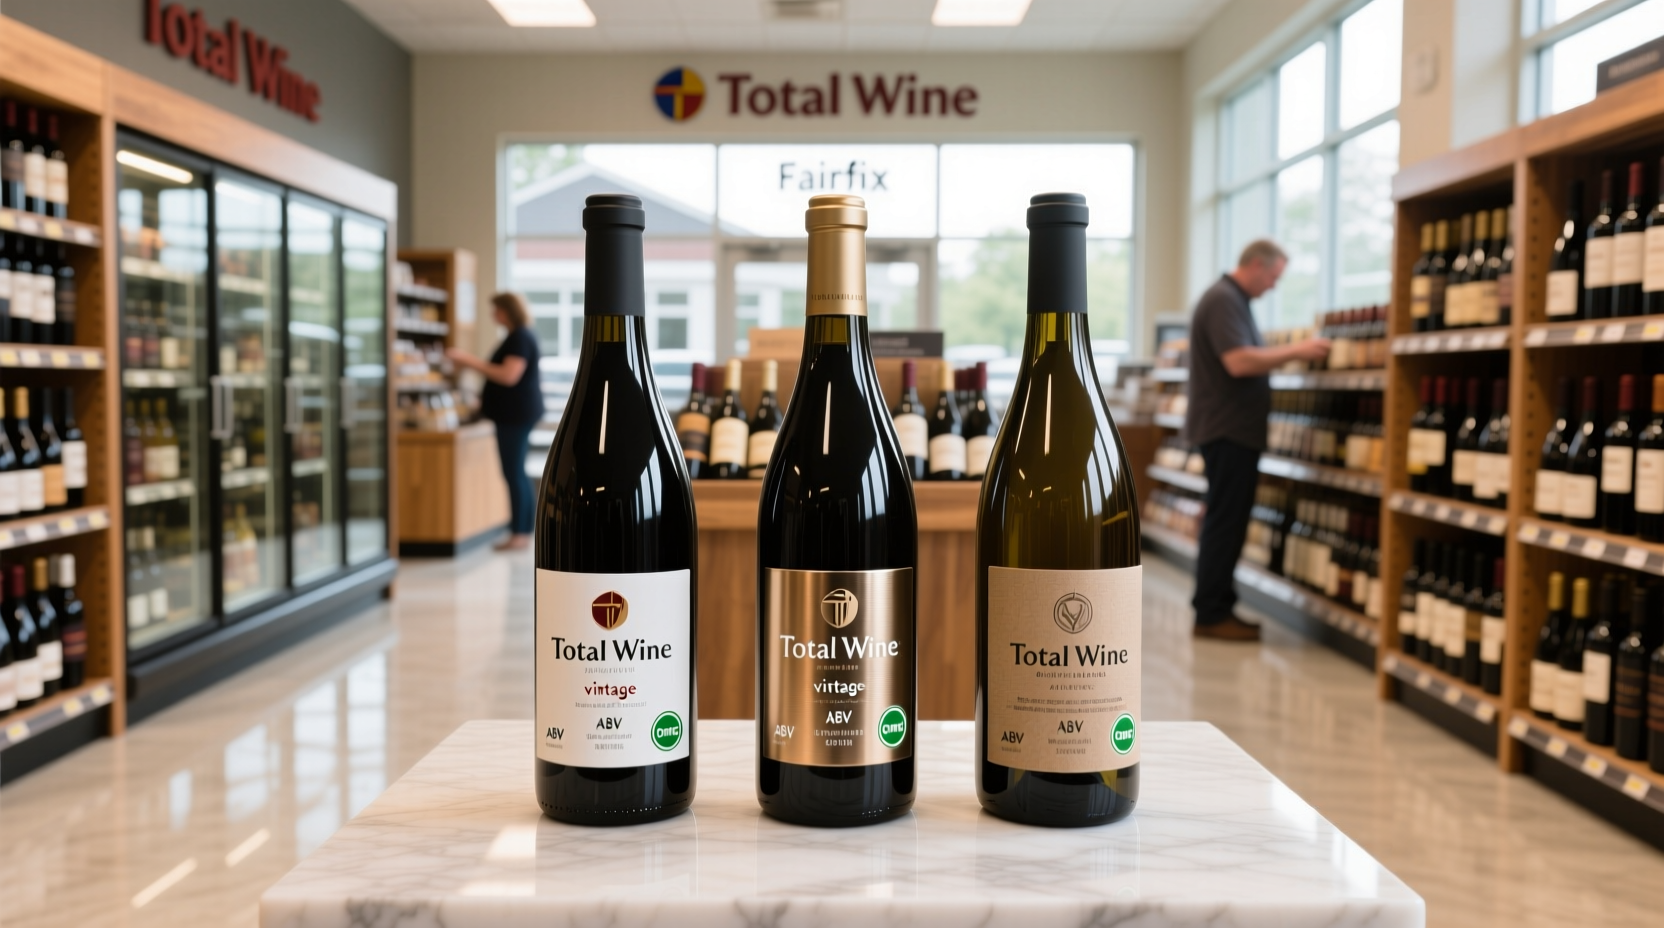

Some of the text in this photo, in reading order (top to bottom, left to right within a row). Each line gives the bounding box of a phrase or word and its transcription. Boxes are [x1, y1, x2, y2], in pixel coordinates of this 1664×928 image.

[245, 28, 322, 123] Wine
[717, 71, 979, 118] Total Wine
[779, 160, 889, 191] Fairfix
[551, 637, 672, 662] Total Wine
[780, 635, 899, 660] Total Wine
[1010, 642, 1128, 667] Total Wine
[546, 727, 565, 740] ABV
[596, 717, 622, 730] ABV
[1001, 731, 1024, 744] ABV
